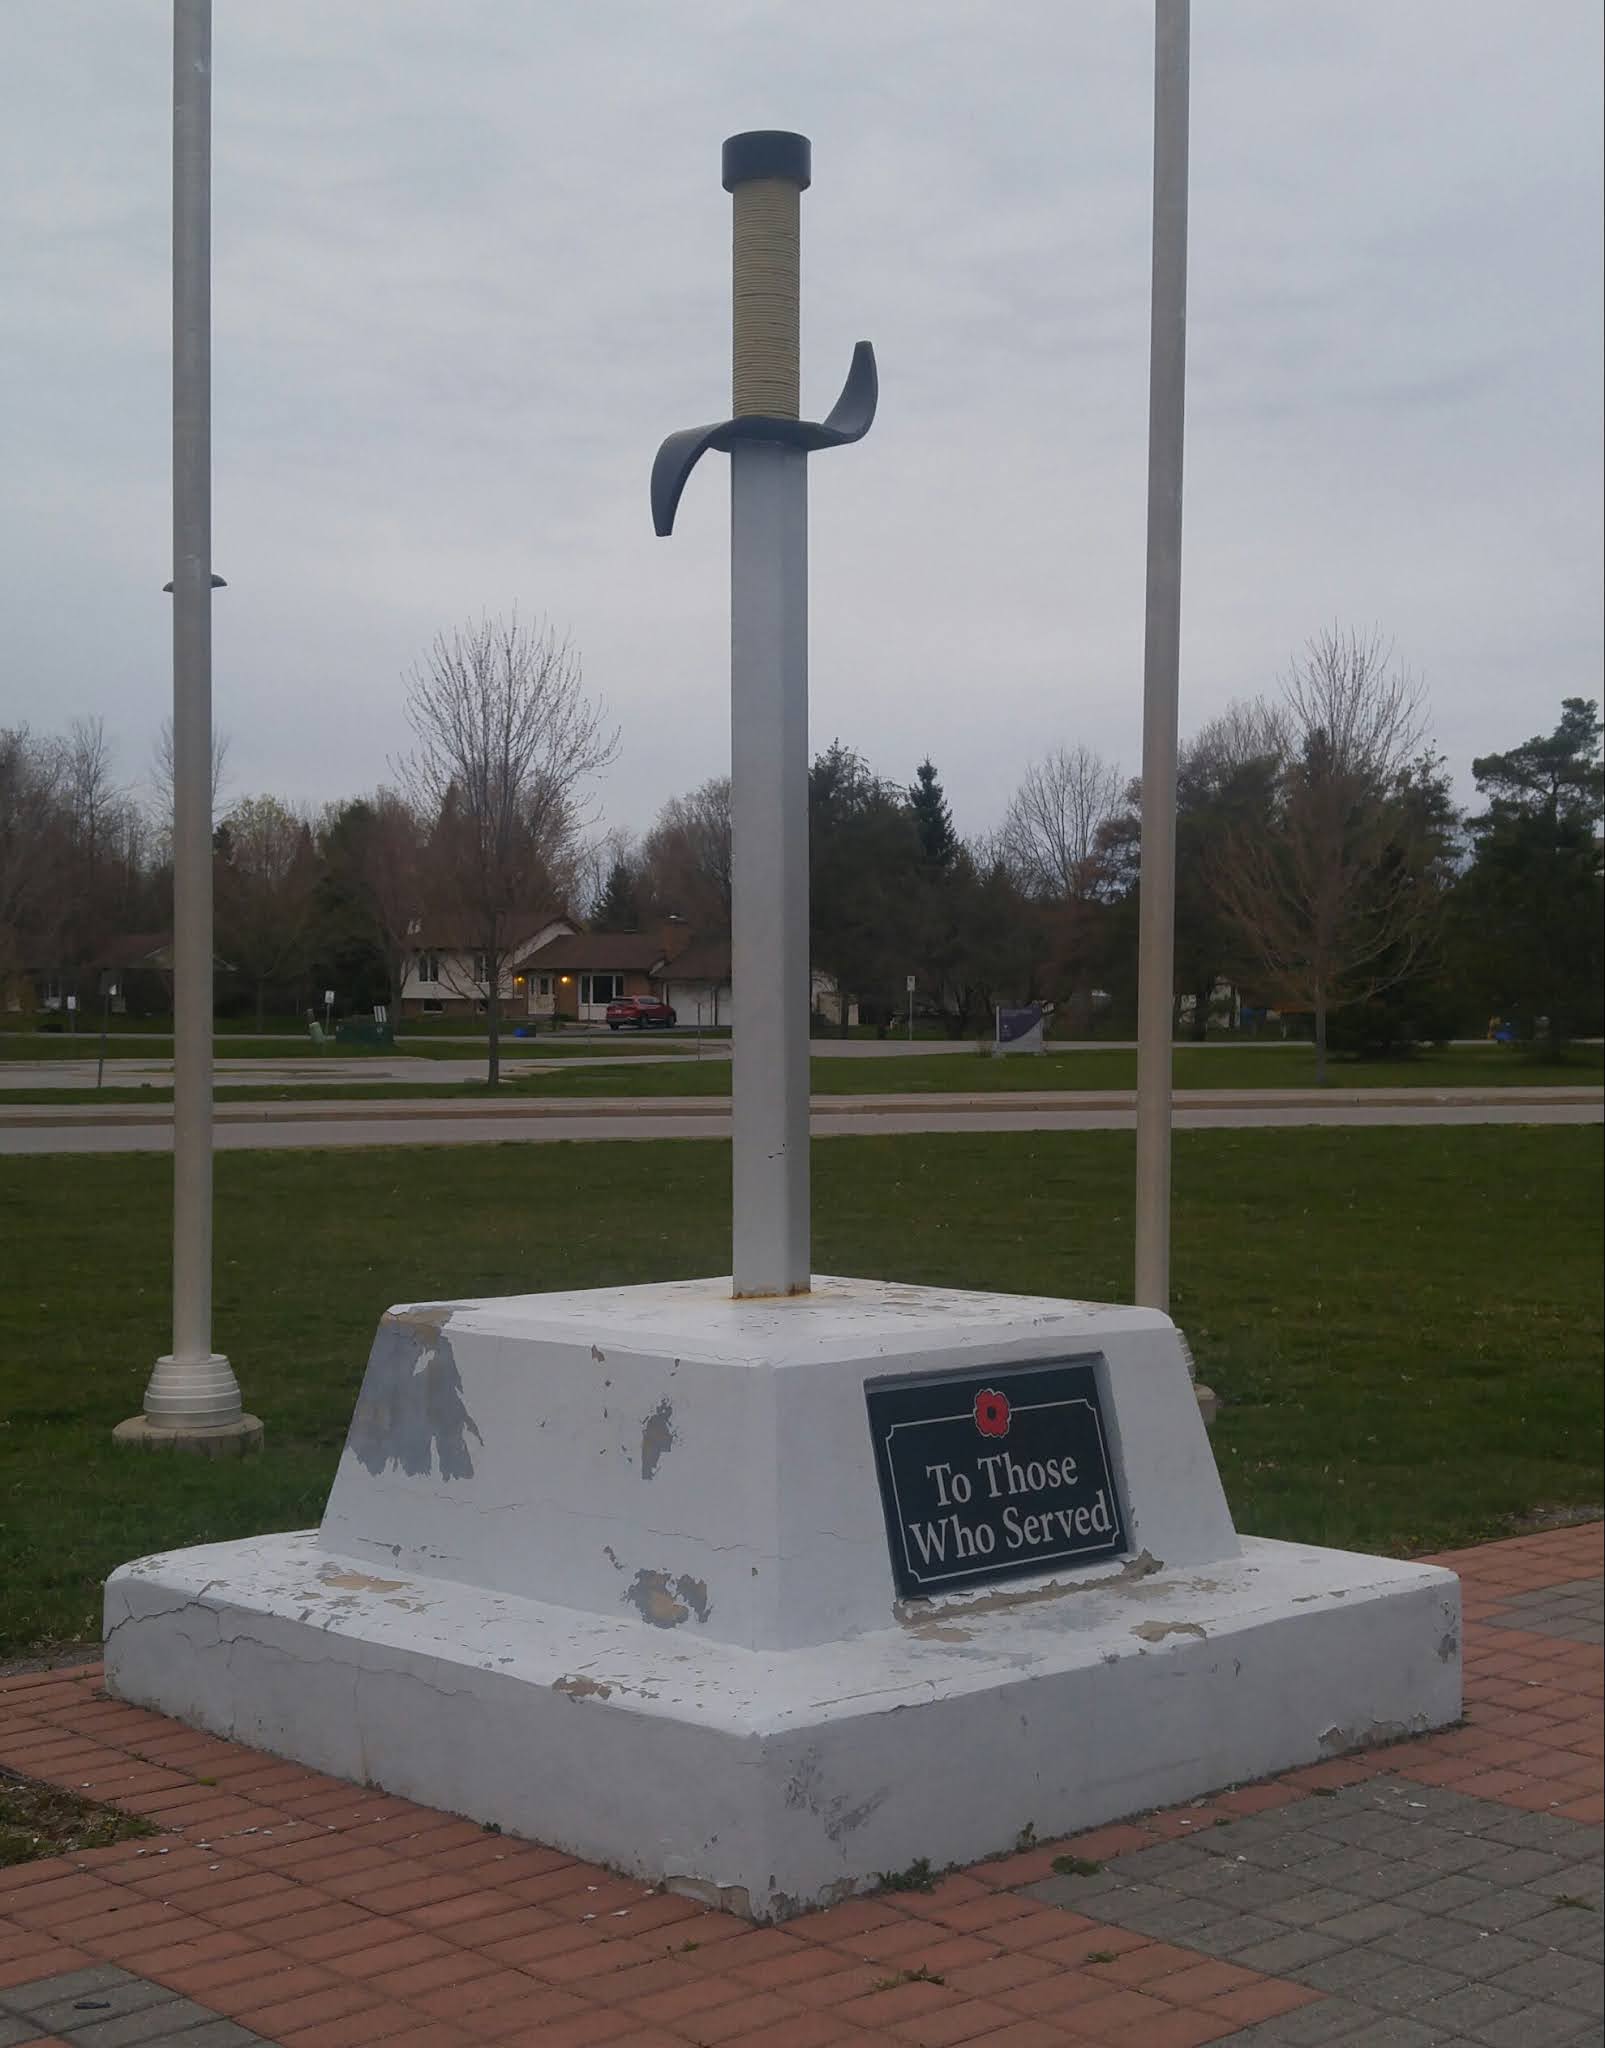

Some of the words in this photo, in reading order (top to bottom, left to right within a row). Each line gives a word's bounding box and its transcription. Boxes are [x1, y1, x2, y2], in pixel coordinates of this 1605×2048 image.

[927, 1463, 971, 1506] To
[977, 1452, 1078, 1498] Those
[910, 1515, 995, 1565] Who
[1002, 1490, 1112, 1549] Served
